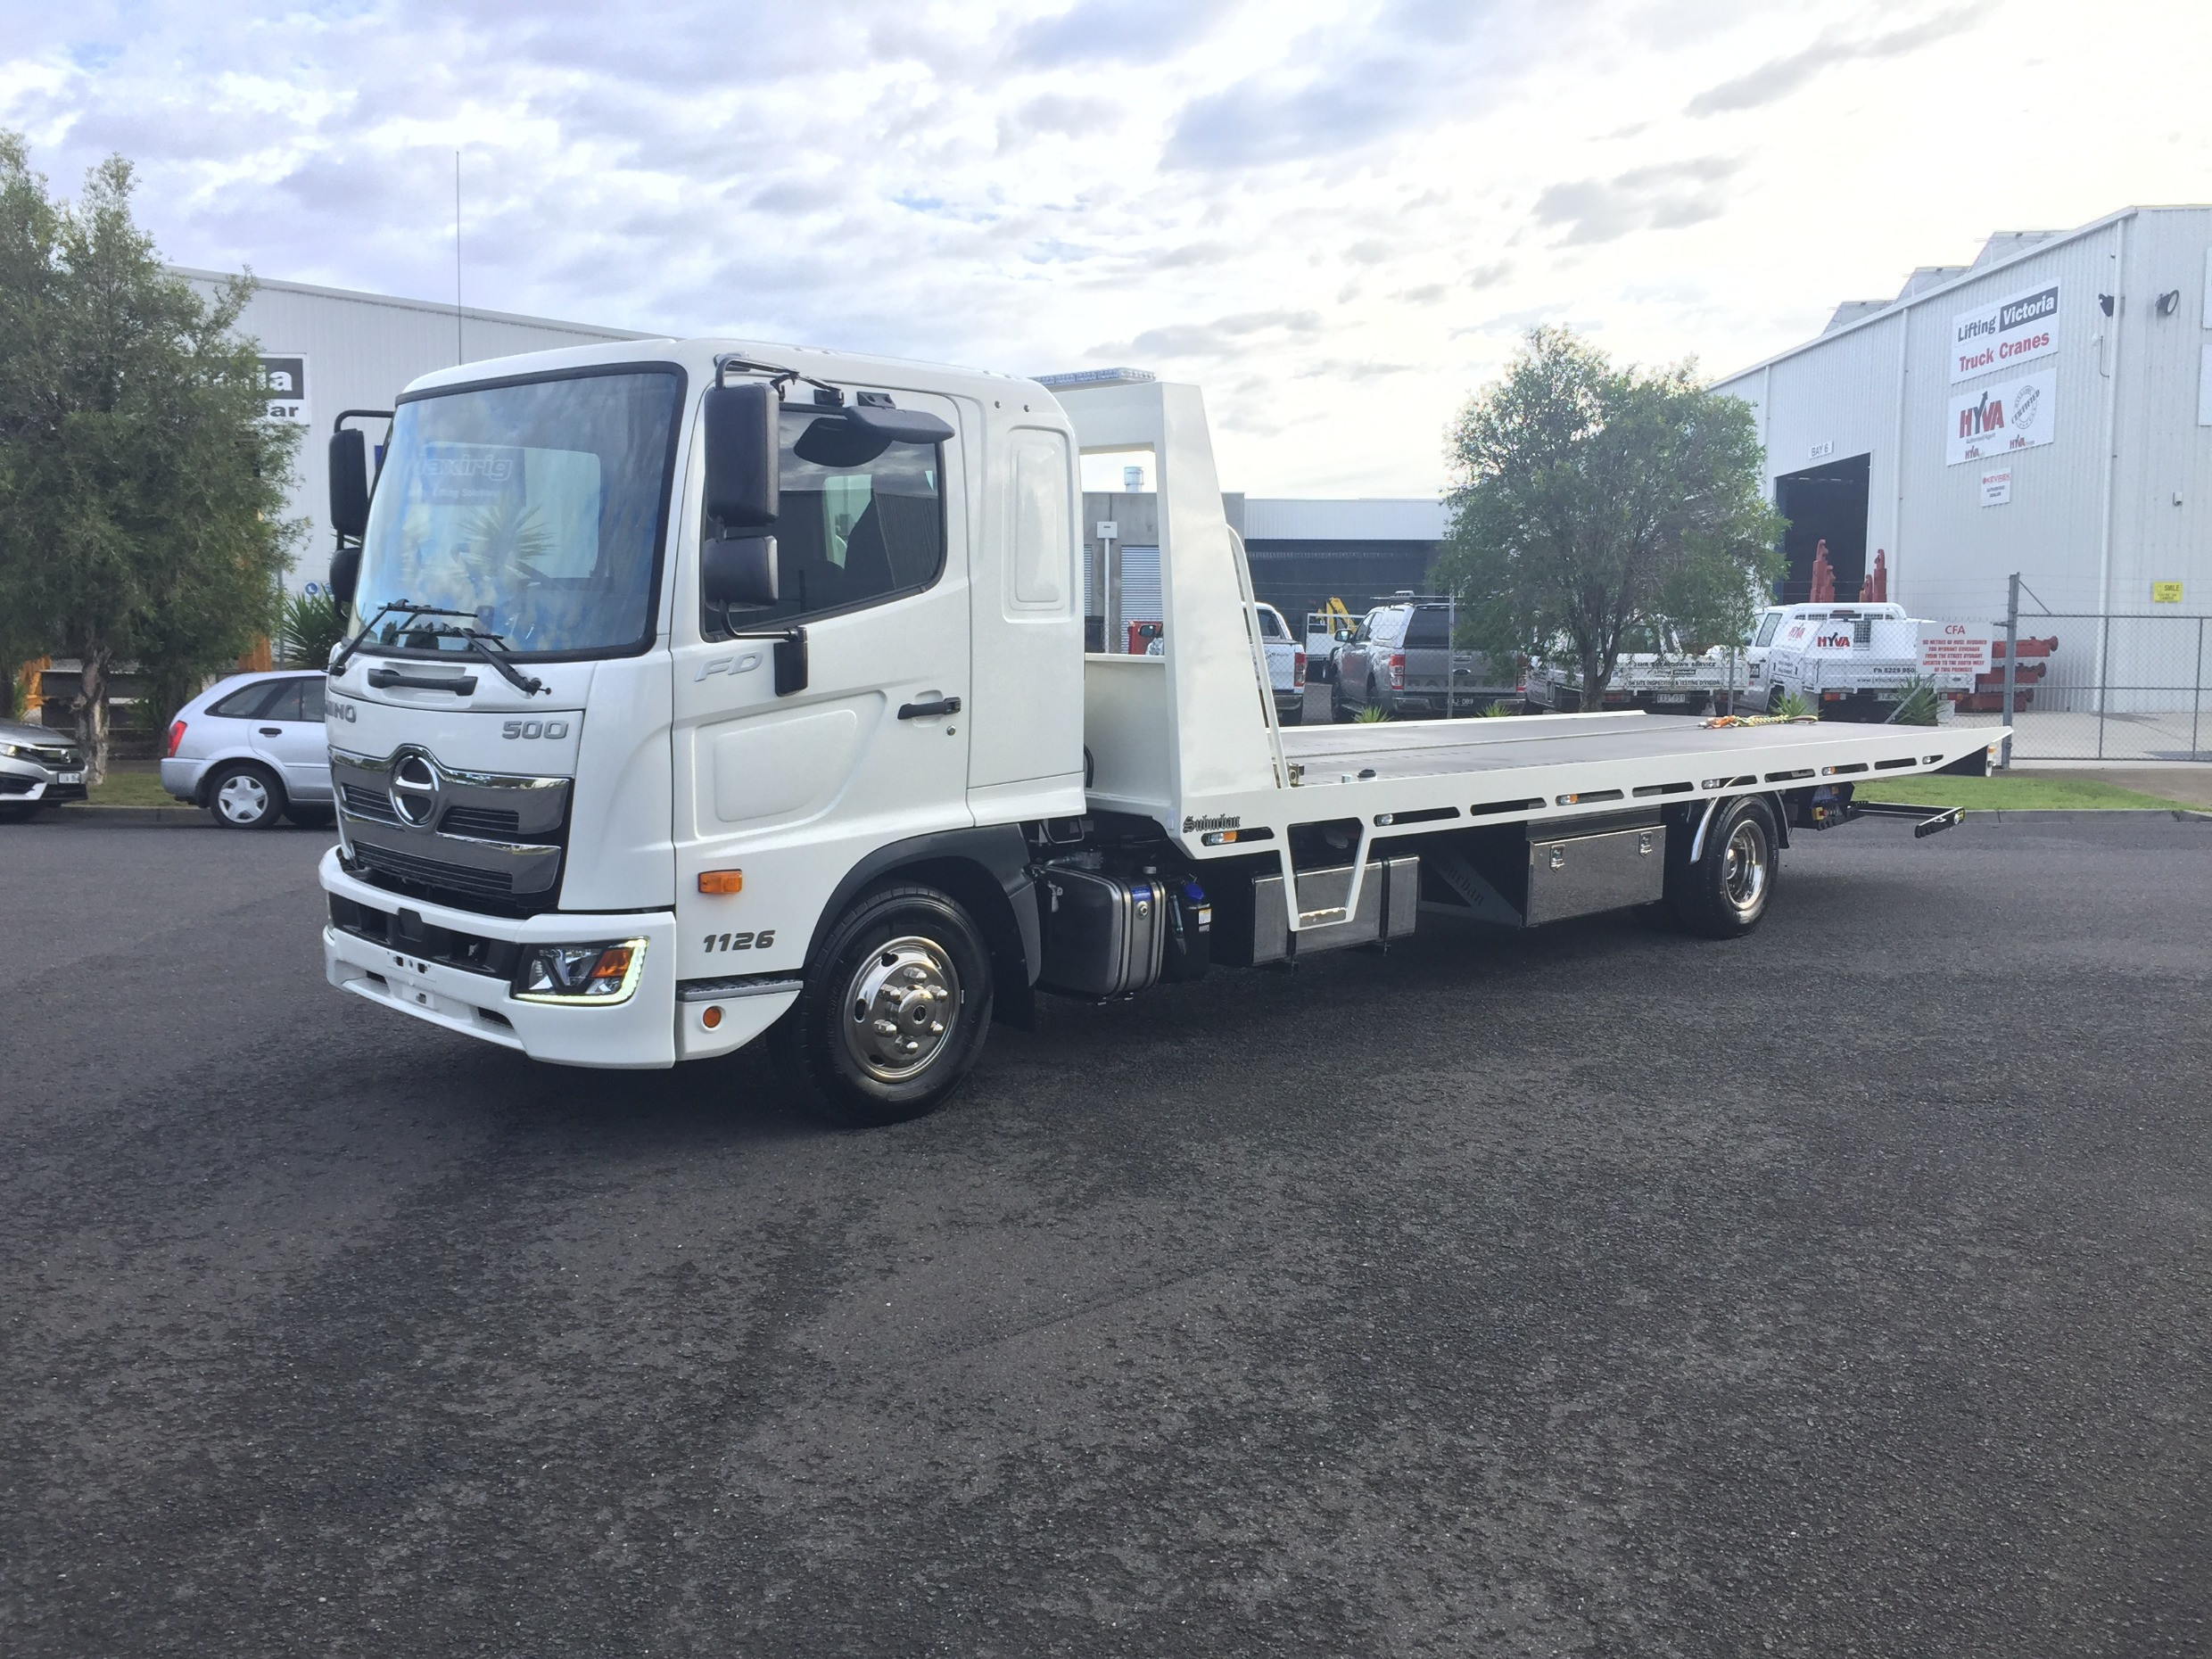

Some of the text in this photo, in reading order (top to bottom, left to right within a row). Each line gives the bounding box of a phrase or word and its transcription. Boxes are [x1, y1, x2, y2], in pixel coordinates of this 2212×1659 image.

[1958, 294, 2055, 343] Lifting Victoria
[1960, 332, 2050, 372] Truck Cranes
[1960, 391, 2004, 438] HYVA
[2011, 389, 2041, 424] CERTIFIED
[1812, 445, 1823, 457] BAY
[2010, 433, 2026, 450] HYVA
[1817, 632, 1851, 648] HYVA
[1944, 624, 1966, 634] CFA
[694, 651, 763, 683] FD
[501, 720, 570, 739] 500
[1182, 813, 1241, 833] Suburban
[703, 929, 776, 953] 1126
